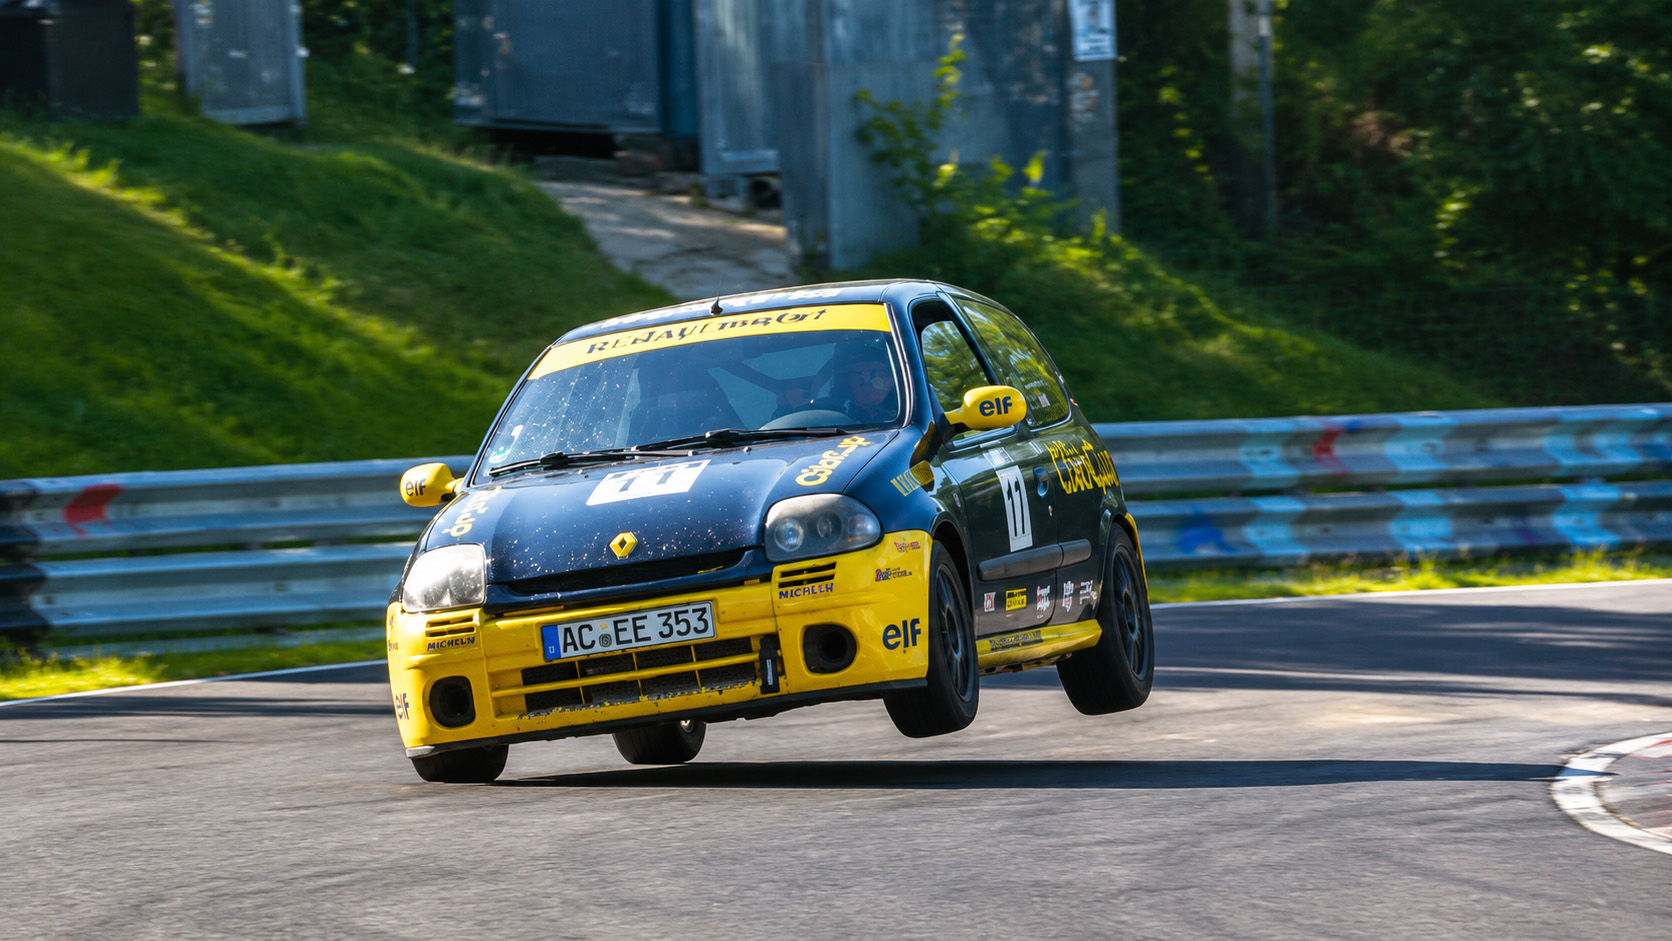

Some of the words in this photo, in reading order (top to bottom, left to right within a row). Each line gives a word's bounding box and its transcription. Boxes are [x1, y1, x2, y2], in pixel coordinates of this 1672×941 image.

[979, 396, 1013, 417] elf
[406, 479, 426, 496] elf
[563, 624, 596, 653] AC
[613, 615, 651, 645] EE
[657, 607, 709, 639] 353
[882, 618, 922, 650] elf
